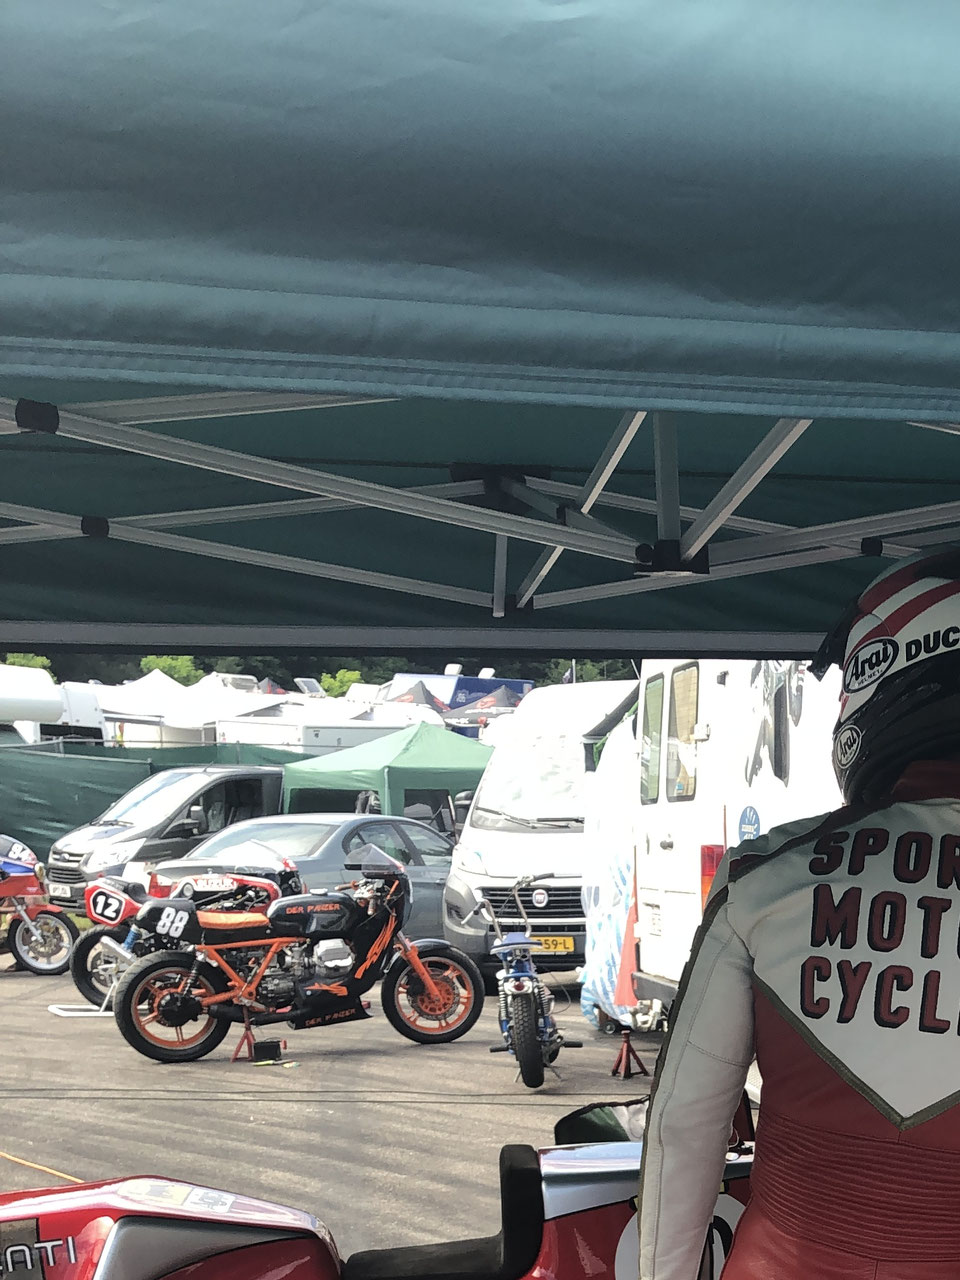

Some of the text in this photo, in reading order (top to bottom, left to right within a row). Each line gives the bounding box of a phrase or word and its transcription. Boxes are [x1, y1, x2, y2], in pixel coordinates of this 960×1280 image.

[847, 641, 891, 688] Arai
[840, 729, 857, 758] Arai
[95, 895, 118, 919] 12
[285, 905, 304, 915] DER
[156, 906, 189, 938] 88
[536, 938, 569, 949] 59-L
[0, 1236, 77, 1272] ATI
